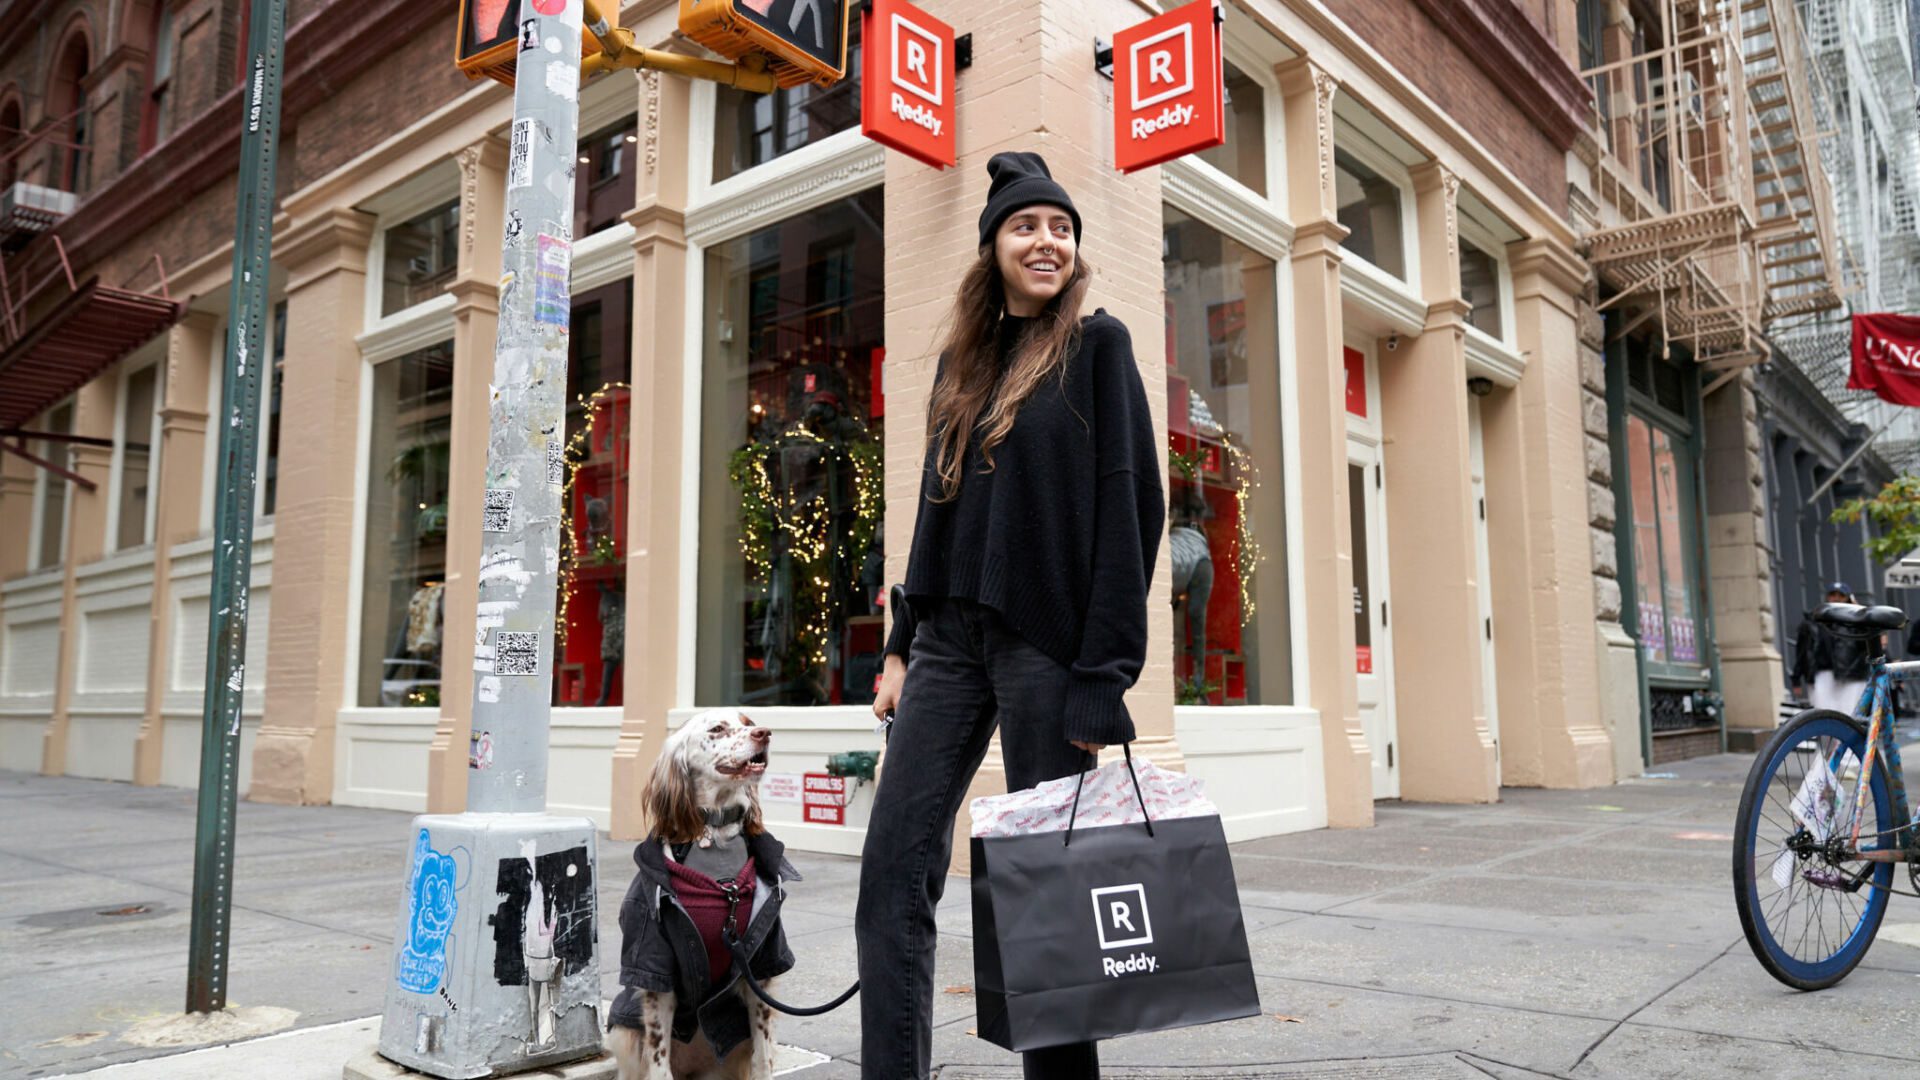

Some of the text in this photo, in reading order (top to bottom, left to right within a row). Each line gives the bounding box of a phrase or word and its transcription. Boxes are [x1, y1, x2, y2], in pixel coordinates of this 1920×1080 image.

[908, 39, 928, 84] R
[1150, 50, 1175, 84] R
[252, 69, 264, 106] KNOWN
[249, 107, 261, 131] ALSO
[805, 777, 843, 791] SPRINKLERS
[809, 806, 838, 821] BUILDING
[1110, 901, 1136, 932] R
